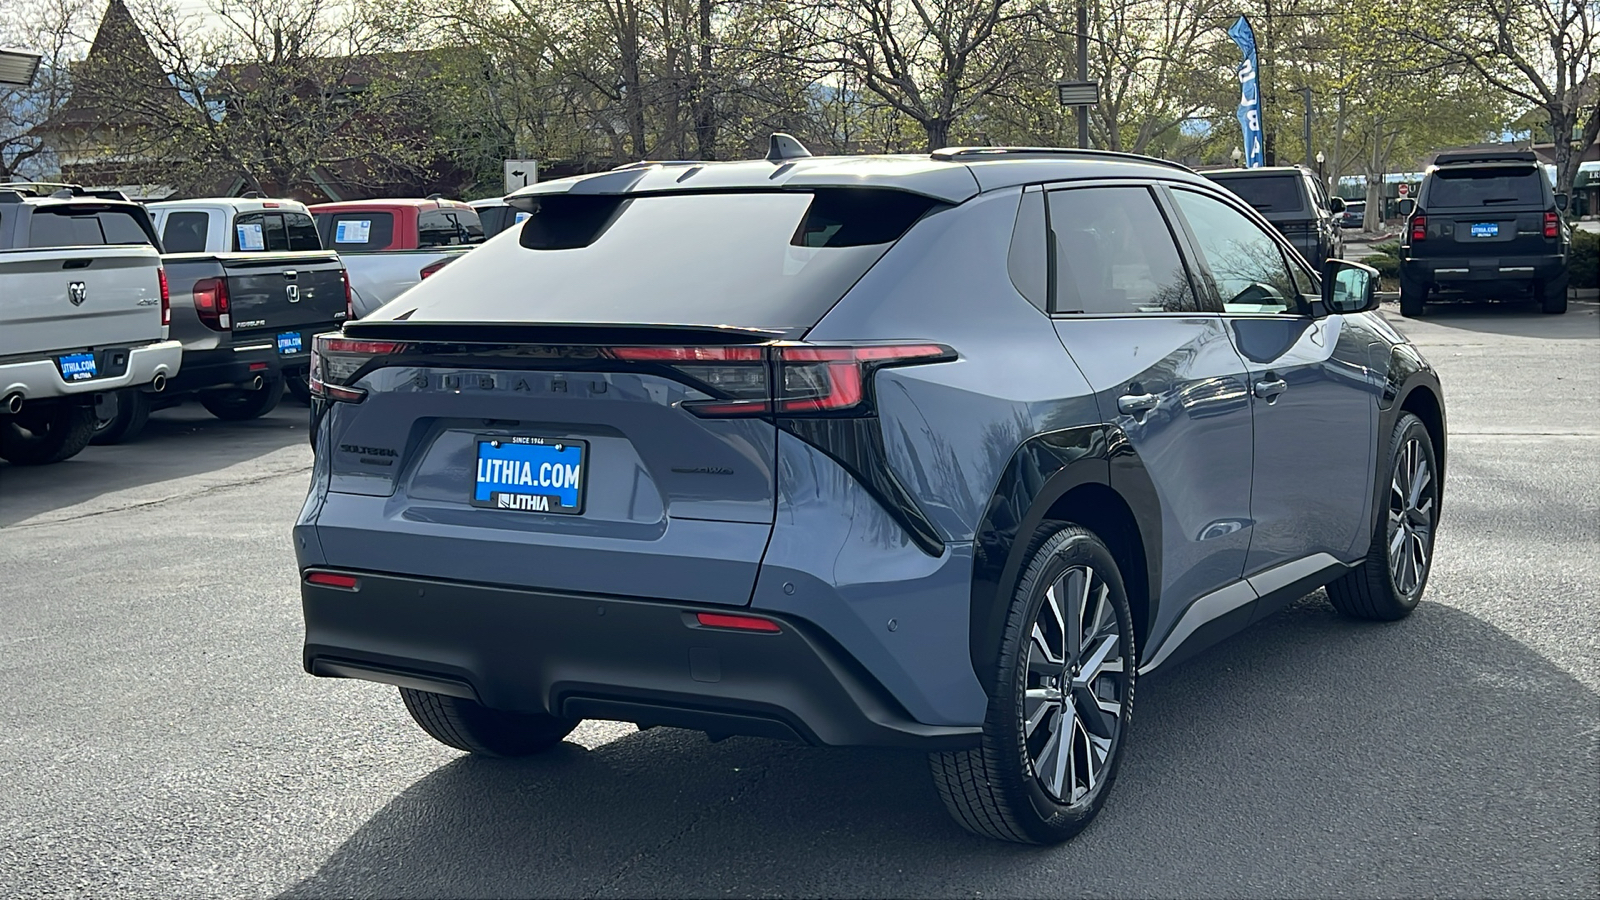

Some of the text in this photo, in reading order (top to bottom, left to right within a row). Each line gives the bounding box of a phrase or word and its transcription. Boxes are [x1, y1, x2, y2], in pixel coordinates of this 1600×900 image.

[413, 374, 608, 394] SUBARU
[512, 436, 529, 444] SINCE
[340, 444, 399, 457] SOLTERRA
[477, 458, 580, 490] LITHIA.COM
[509, 493, 549, 511] LITHIA
